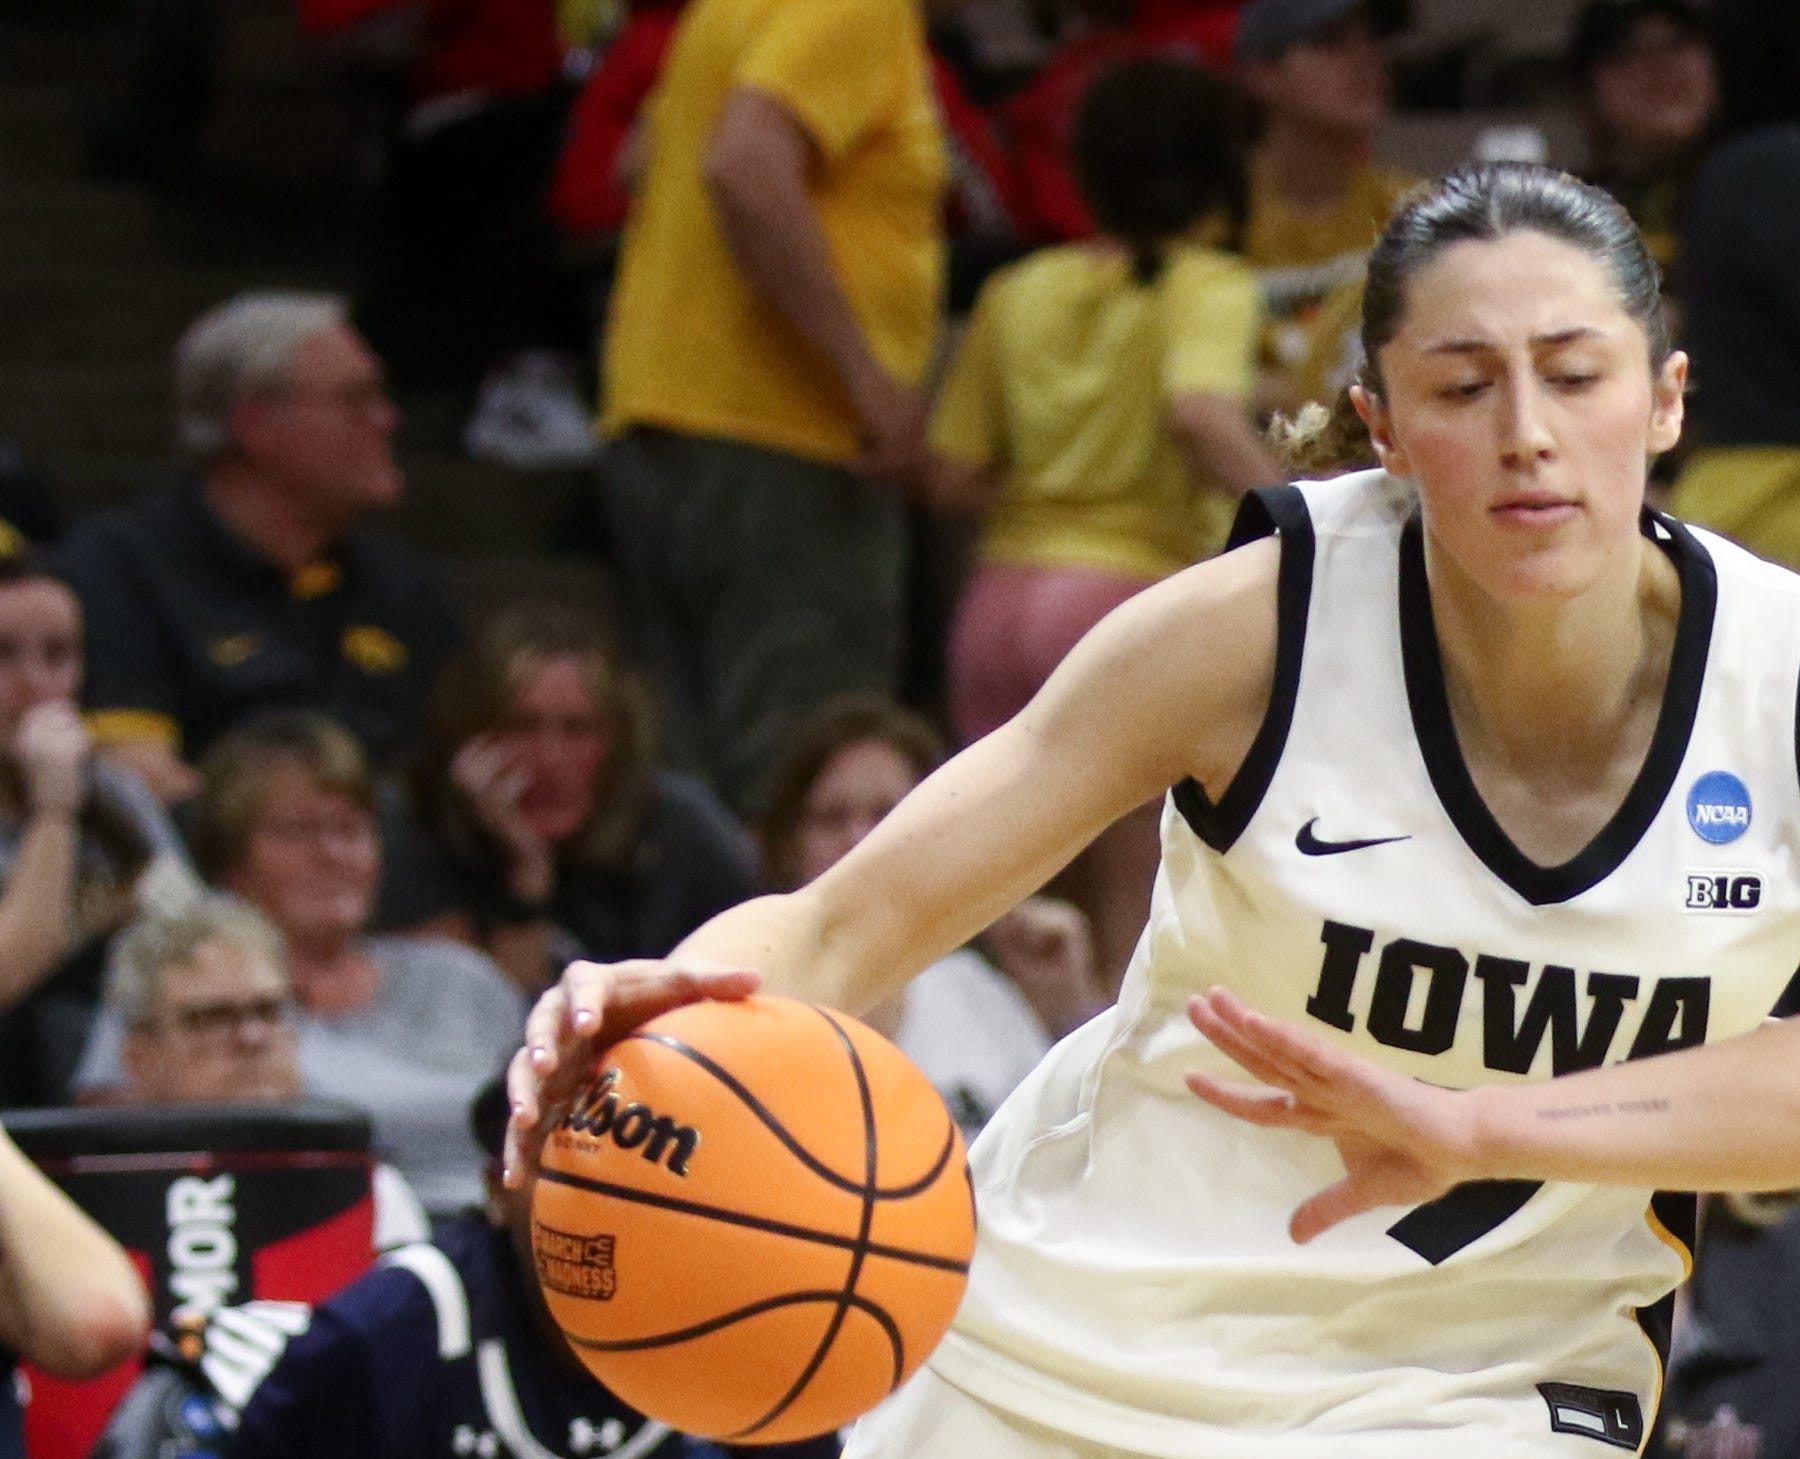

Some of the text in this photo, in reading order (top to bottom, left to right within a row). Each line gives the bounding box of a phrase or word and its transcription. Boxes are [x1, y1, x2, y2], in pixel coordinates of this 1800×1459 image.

[1696, 803, 1748, 825] NCAA
[1305, 919, 1712, 1078] IOWA
[1615, 1408, 1629, 1430] L
